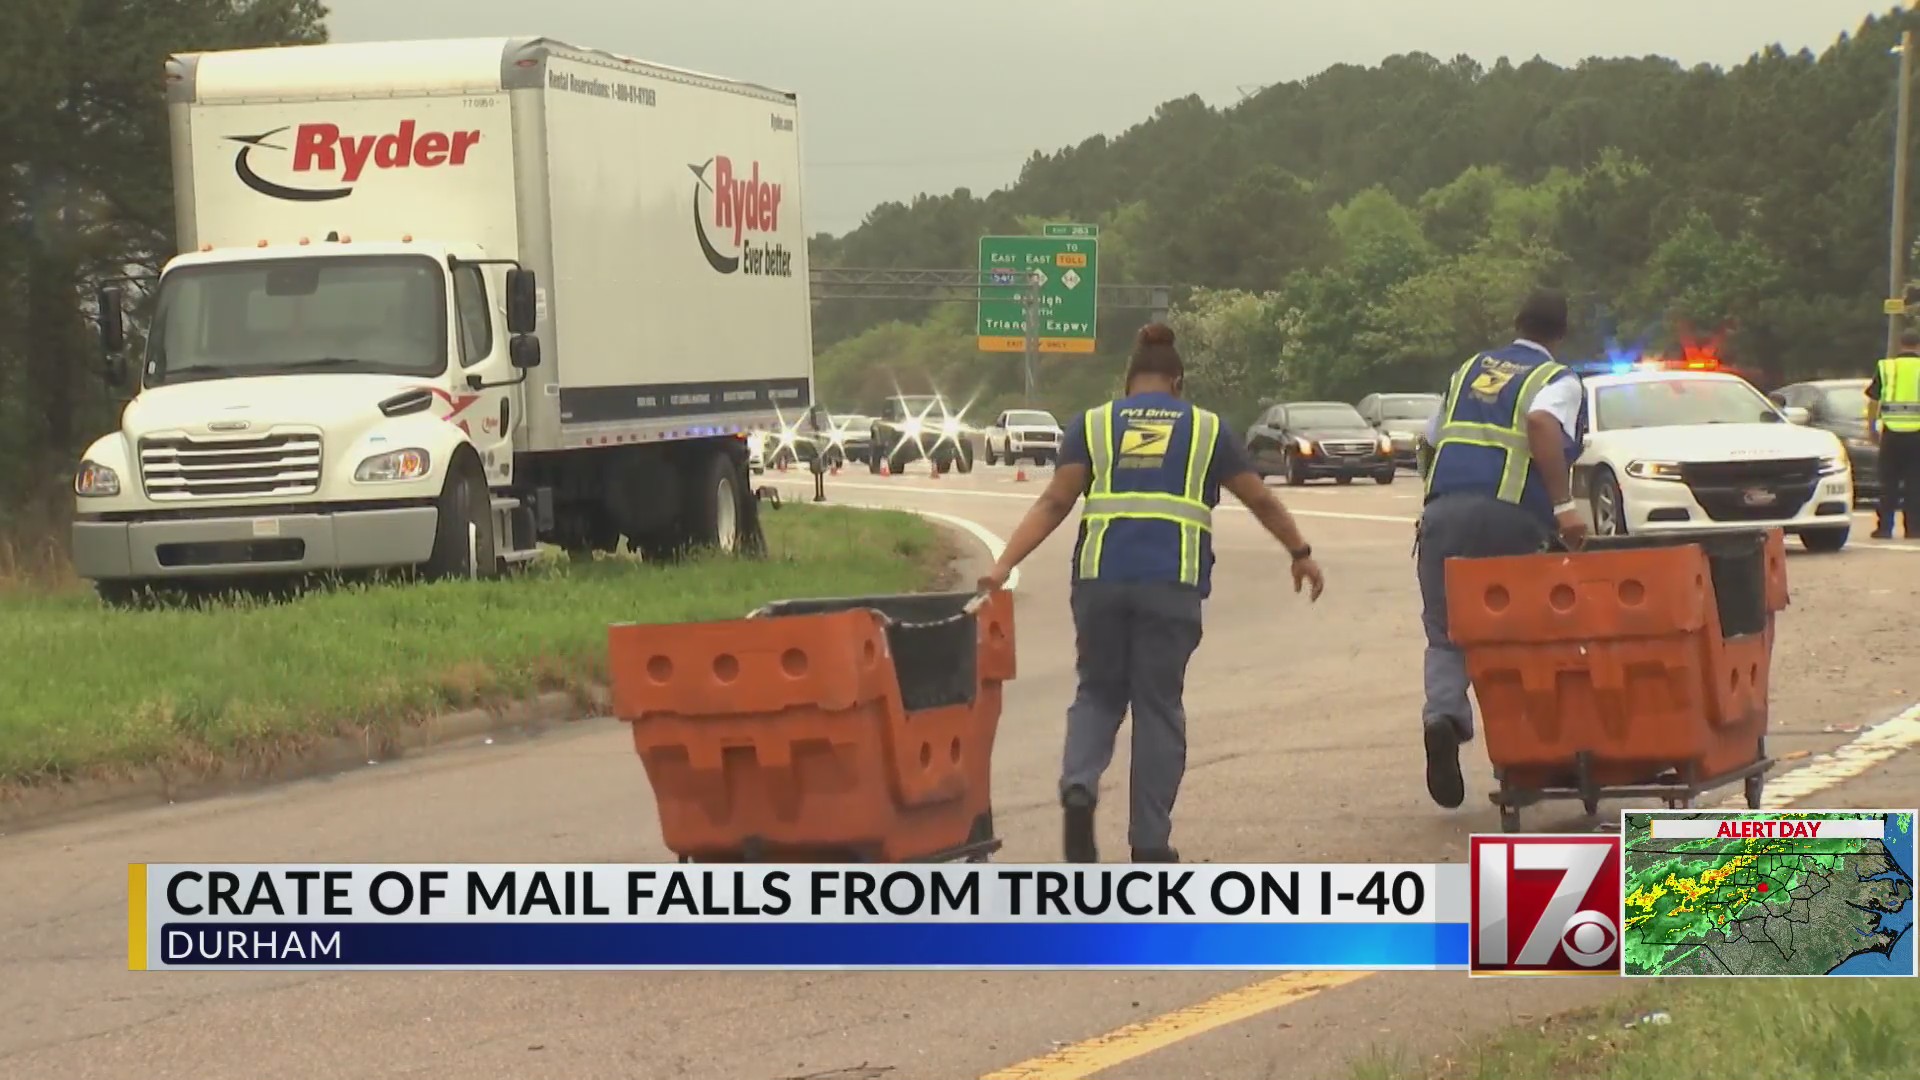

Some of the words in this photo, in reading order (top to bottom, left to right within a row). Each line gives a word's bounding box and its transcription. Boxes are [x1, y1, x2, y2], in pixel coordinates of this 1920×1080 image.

[548, 69, 568, 91] Rental
[292, 119, 480, 182] Ryder
[715, 155, 781, 247] Ryder
[1066, 243, 1078, 252] TO
[743, 239, 763, 276] Ever
[765, 241, 792, 277] better.
[991, 253, 1016, 263] EAST
[1025, 254, 1051, 264] EAST
[1060, 256, 1084, 264] TOLL
[1047, 321, 1088, 332] Expwy
[1145, 409, 1184, 418] Driver
